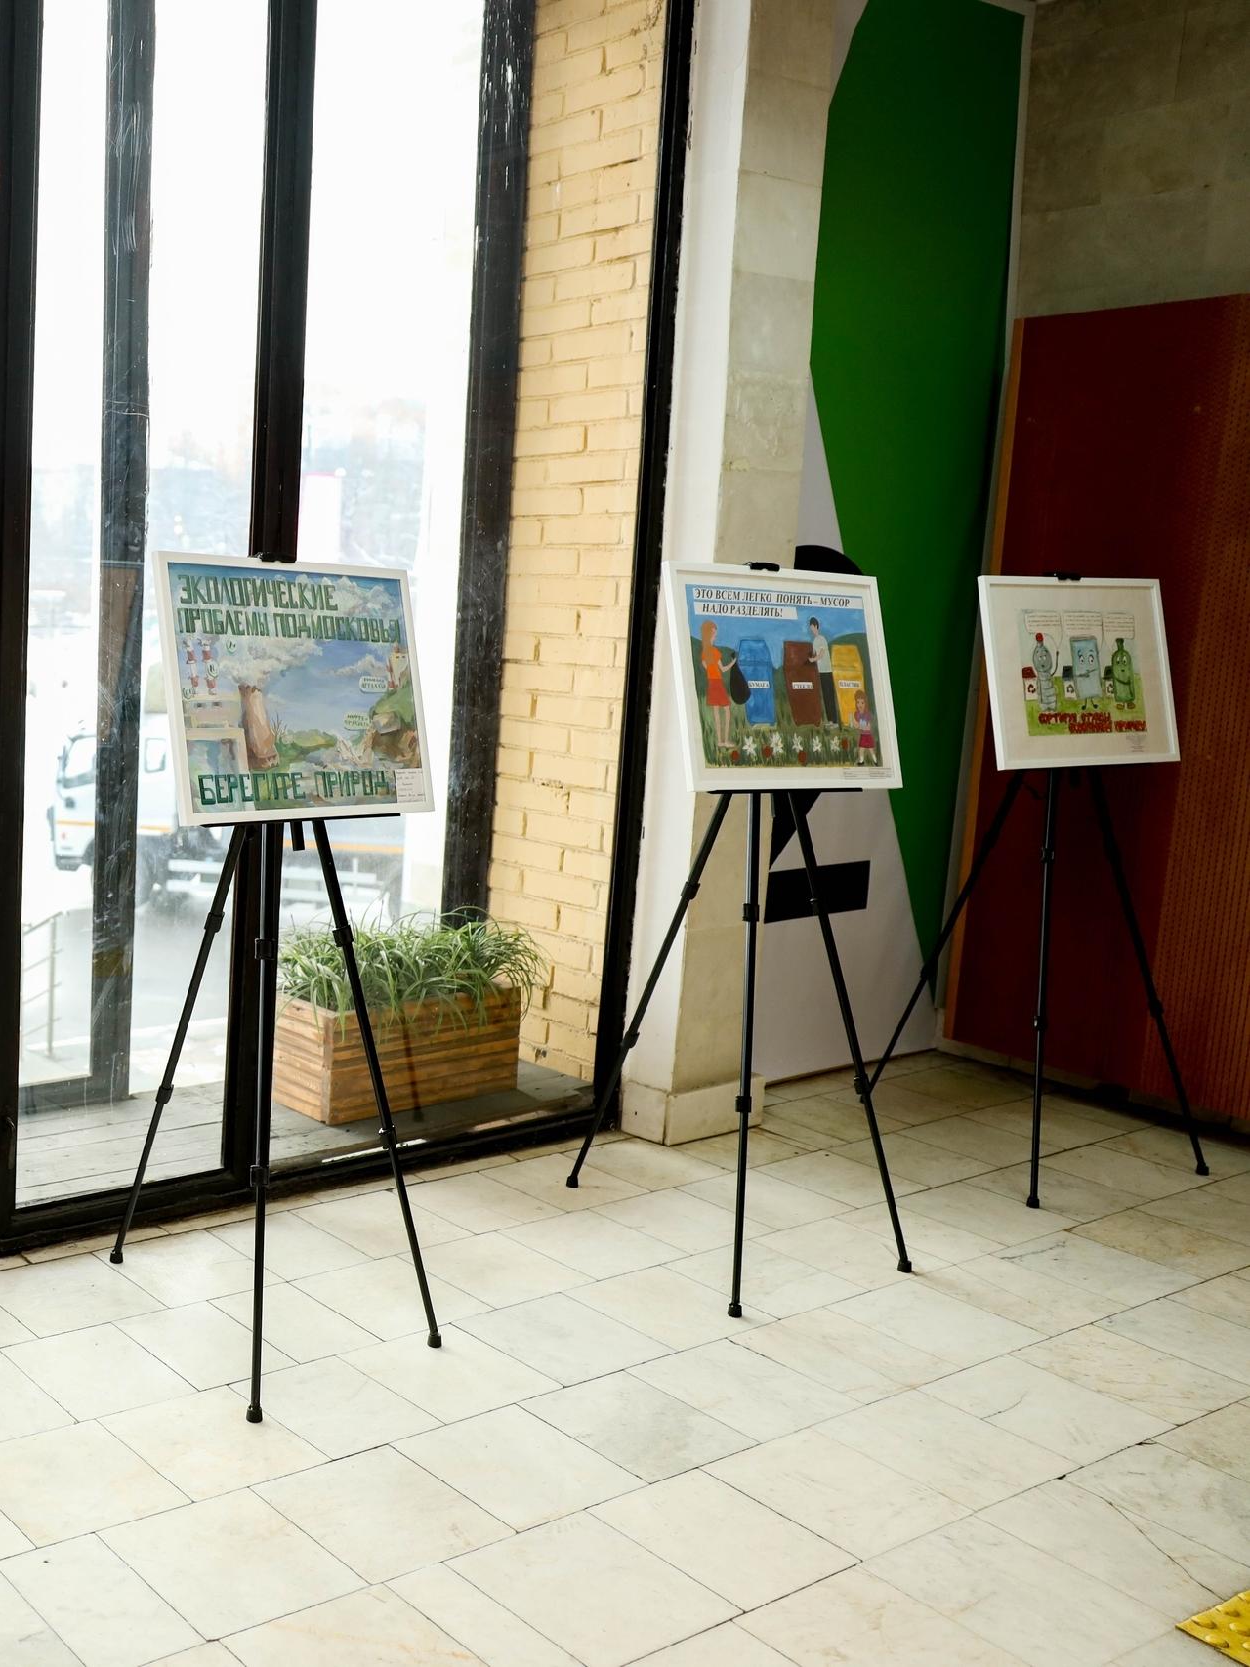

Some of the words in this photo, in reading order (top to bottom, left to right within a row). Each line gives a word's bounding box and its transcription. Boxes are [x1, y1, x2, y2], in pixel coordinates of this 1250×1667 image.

[177, 574, 338, 611] ЭКОЛОГИЧЕСКИЕ
[695, 588, 713, 600] ЭТО
[715, 589, 740, 601] ВСЕМ
[742, 591, 772, 603] ЛЕГКО
[820, 597, 851, 607] МУСОР
[177, 607, 270, 637] ПРОБЛЕМЫ
[273, 612, 400, 644] ПОДМОСКОВЬЯ
[702, 603, 729, 614] НАДО
[730, 604, 783, 618] РАЗДЕЛЯТЬ!
[198, 772, 306, 805] БЕРЕГИТЕ
[314, 770, 396, 798] ПРИРОД
